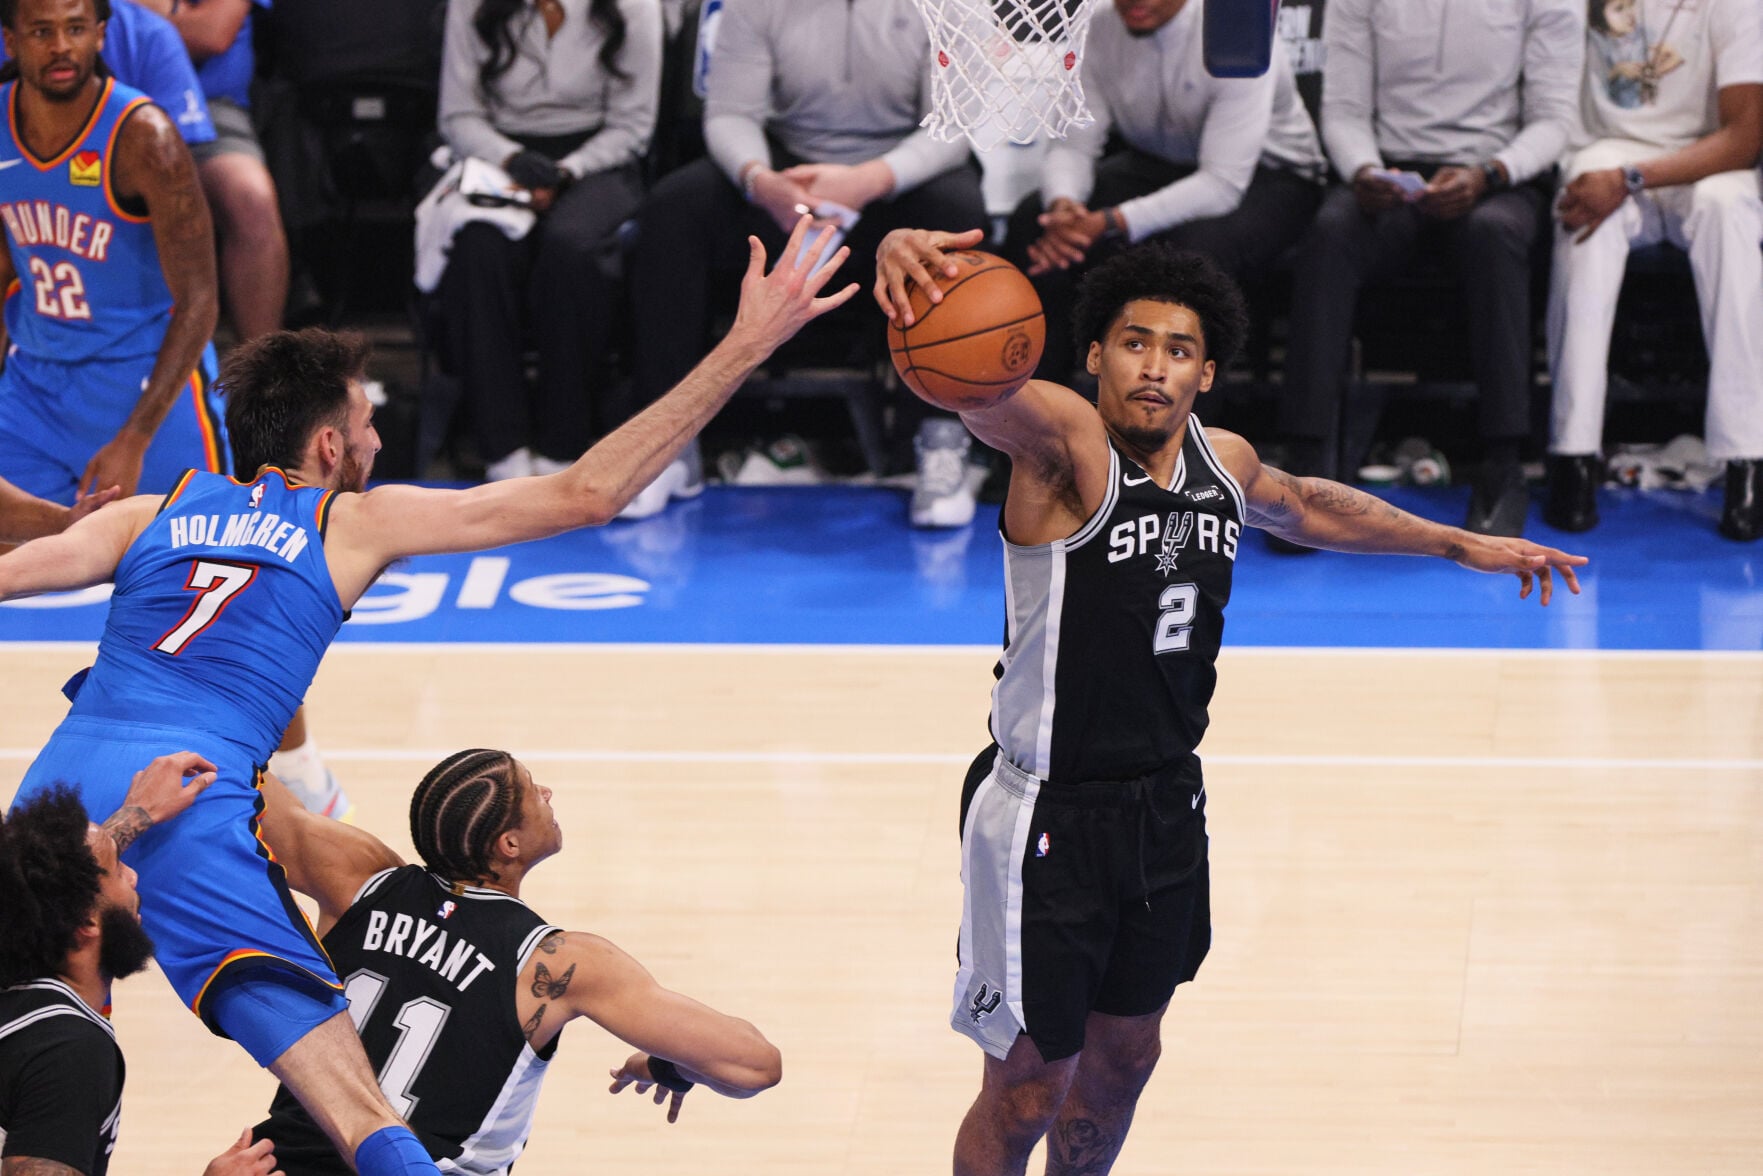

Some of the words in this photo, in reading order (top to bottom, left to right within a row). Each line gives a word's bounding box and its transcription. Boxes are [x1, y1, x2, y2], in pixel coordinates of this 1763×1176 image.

[1, 200, 113, 262] HUNDER
[29, 255, 93, 321] 22
[1191, 489, 1219, 502] LEDGER
[170, 510, 309, 563] HOLMGREN
[1107, 511, 1242, 577] SPURS
[149, 558, 260, 656] 7
[1153, 582, 1199, 656] 2
[362, 909, 496, 992] BRYANT
